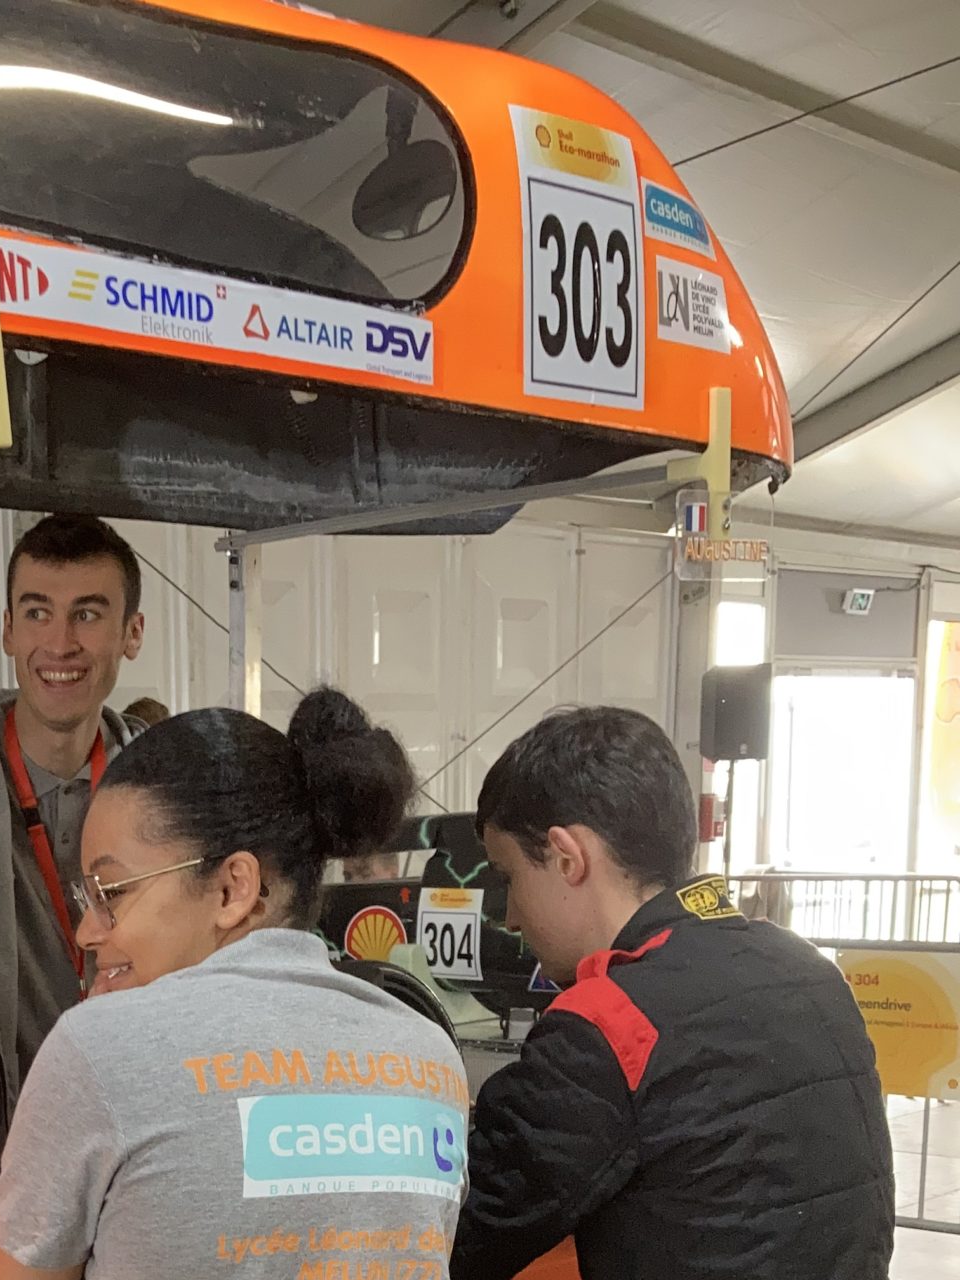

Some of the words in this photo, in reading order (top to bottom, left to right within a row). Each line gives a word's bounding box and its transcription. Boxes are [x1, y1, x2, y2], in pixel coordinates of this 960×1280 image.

[557, 129, 574, 141] Shell
[558, 141, 621, 168] Eco-marathon
[650, 197, 693, 230] casden
[104, 276, 214, 323] SCHMID
[538, 213, 633, 369] 303
[141, 315, 214, 345] Elektronik
[276, 315, 354, 351] ALTAIR
[366, 320, 431, 362] DSV
[685, 537, 769, 562] AUGUSTINE
[424, 922, 473, 968] 304
[855, 973, 880, 986] 304
[184, 1049, 313, 1094] TEAM
[268, 1113, 425, 1157] casden
[269, 1180, 356, 1195] BANQUE
[217, 1231, 302, 1263] Lycée
